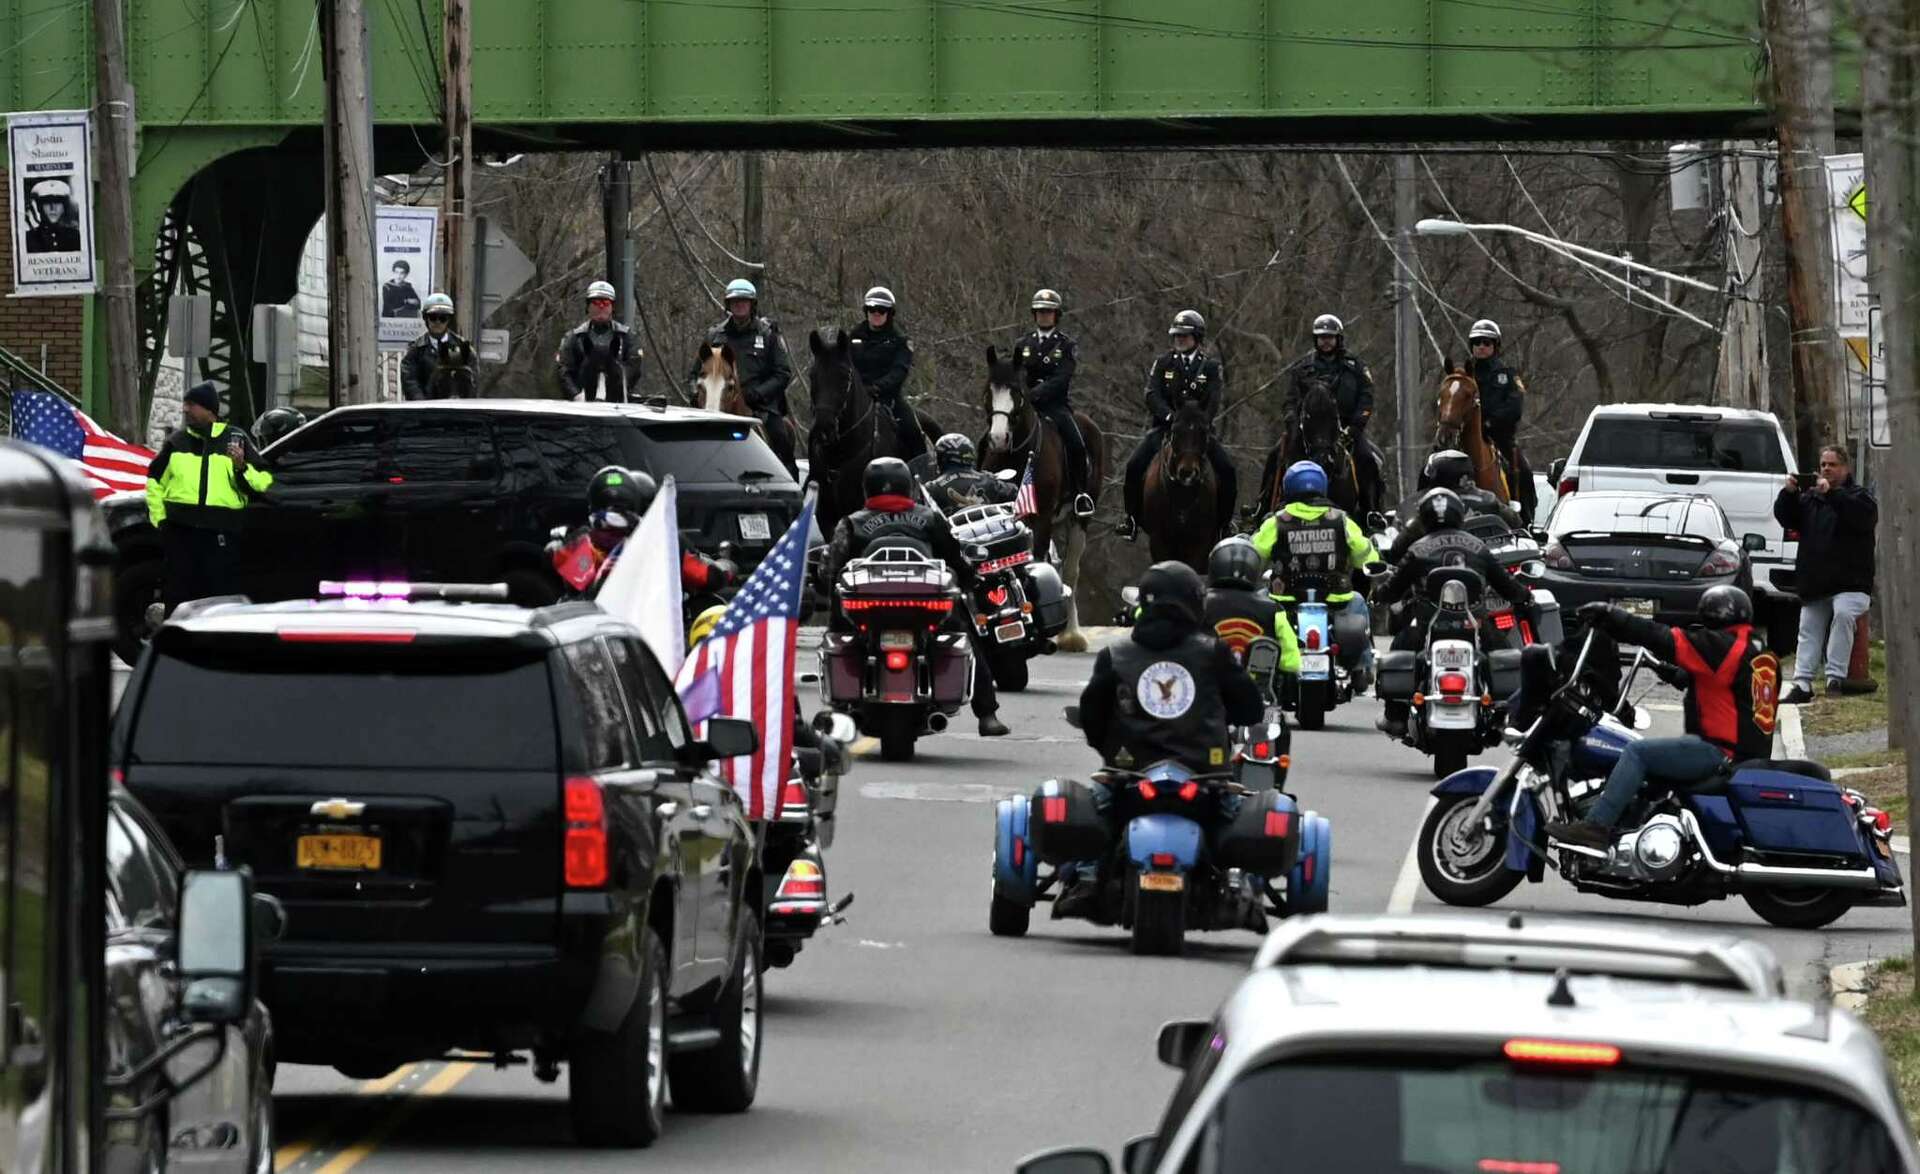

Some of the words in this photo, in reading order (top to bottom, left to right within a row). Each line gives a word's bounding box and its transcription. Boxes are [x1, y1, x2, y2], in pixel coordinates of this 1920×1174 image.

[35, 134, 64, 146] Justin
[28, 256, 81, 266] RENSSELAER
[32, 267, 79, 276] VETERANS
[1287, 528, 1336, 543] PATRIOT
